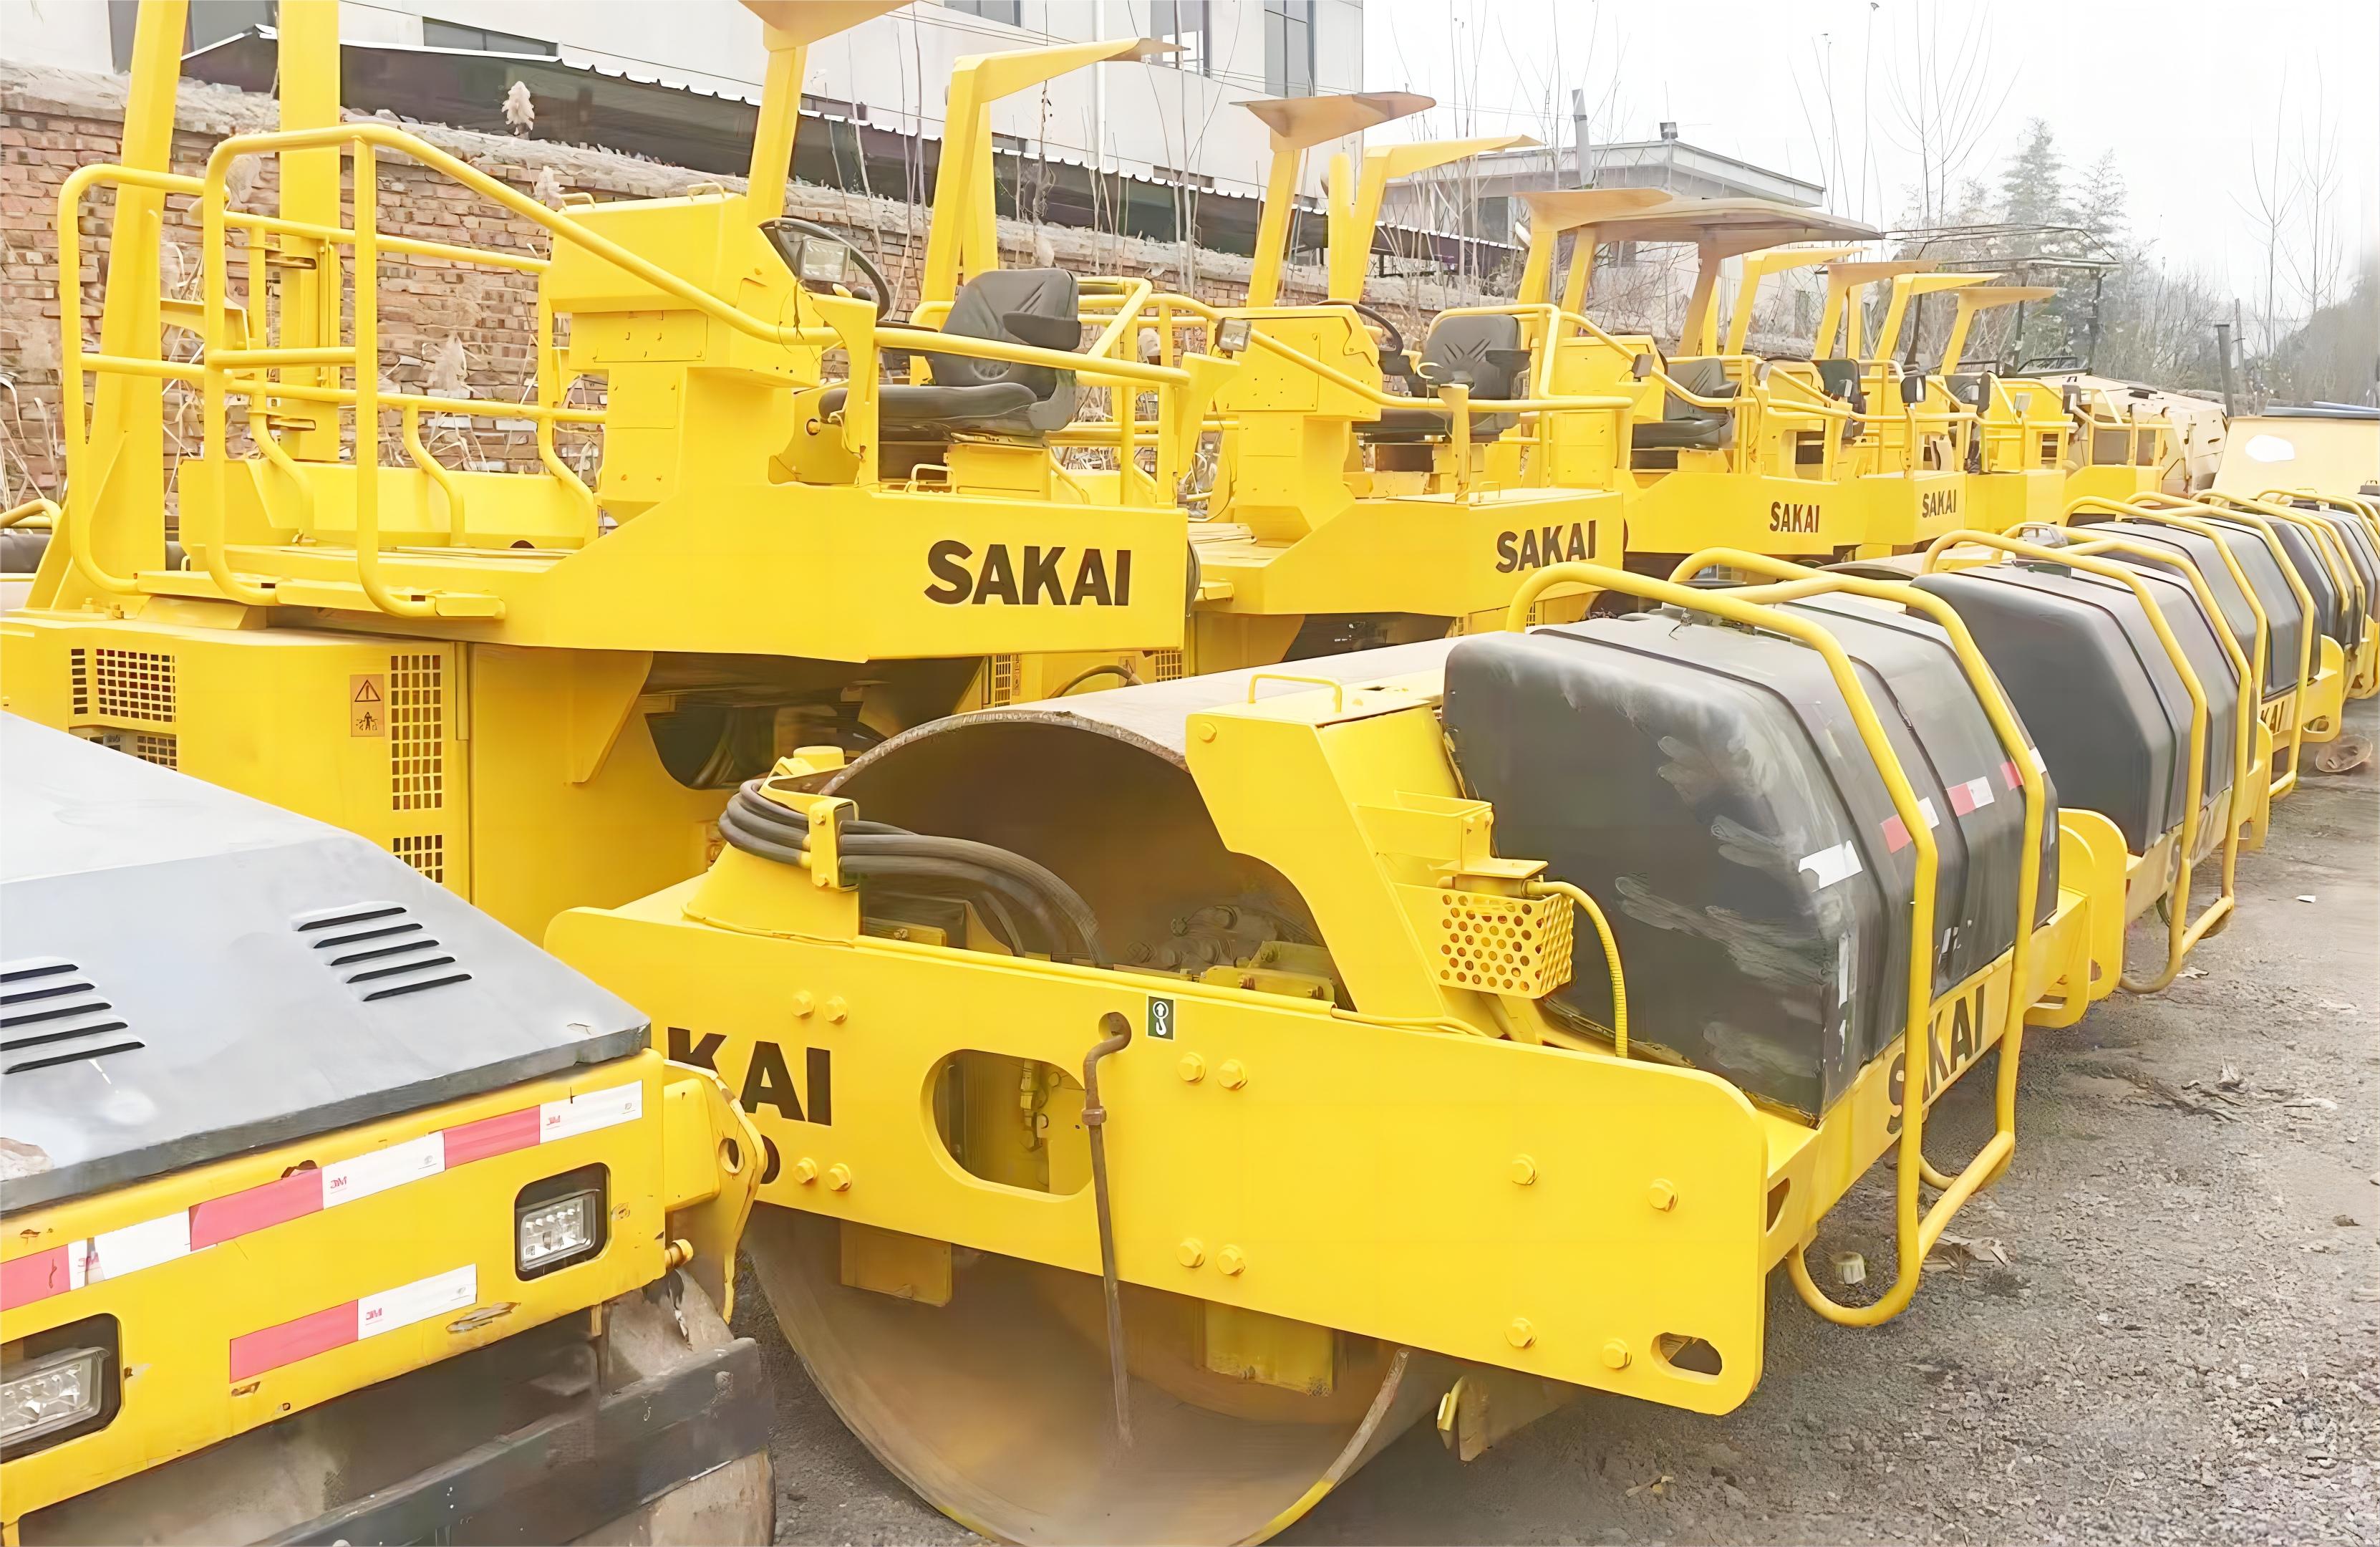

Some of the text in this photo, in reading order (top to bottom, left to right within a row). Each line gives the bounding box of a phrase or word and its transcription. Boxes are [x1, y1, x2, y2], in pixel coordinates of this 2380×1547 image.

[1769, 501, 1820, 533] SAKAI
[1922, 489, 1957, 519] SAKAI
[924, 539, 1131, 606] SAKAI
[1496, 520, 1596, 573] SAKAI
[2260, 700, 2285, 733] KAI
[667, 1026, 832, 1127] KAI
[1887, 983, 1985, 1134] SKAI
